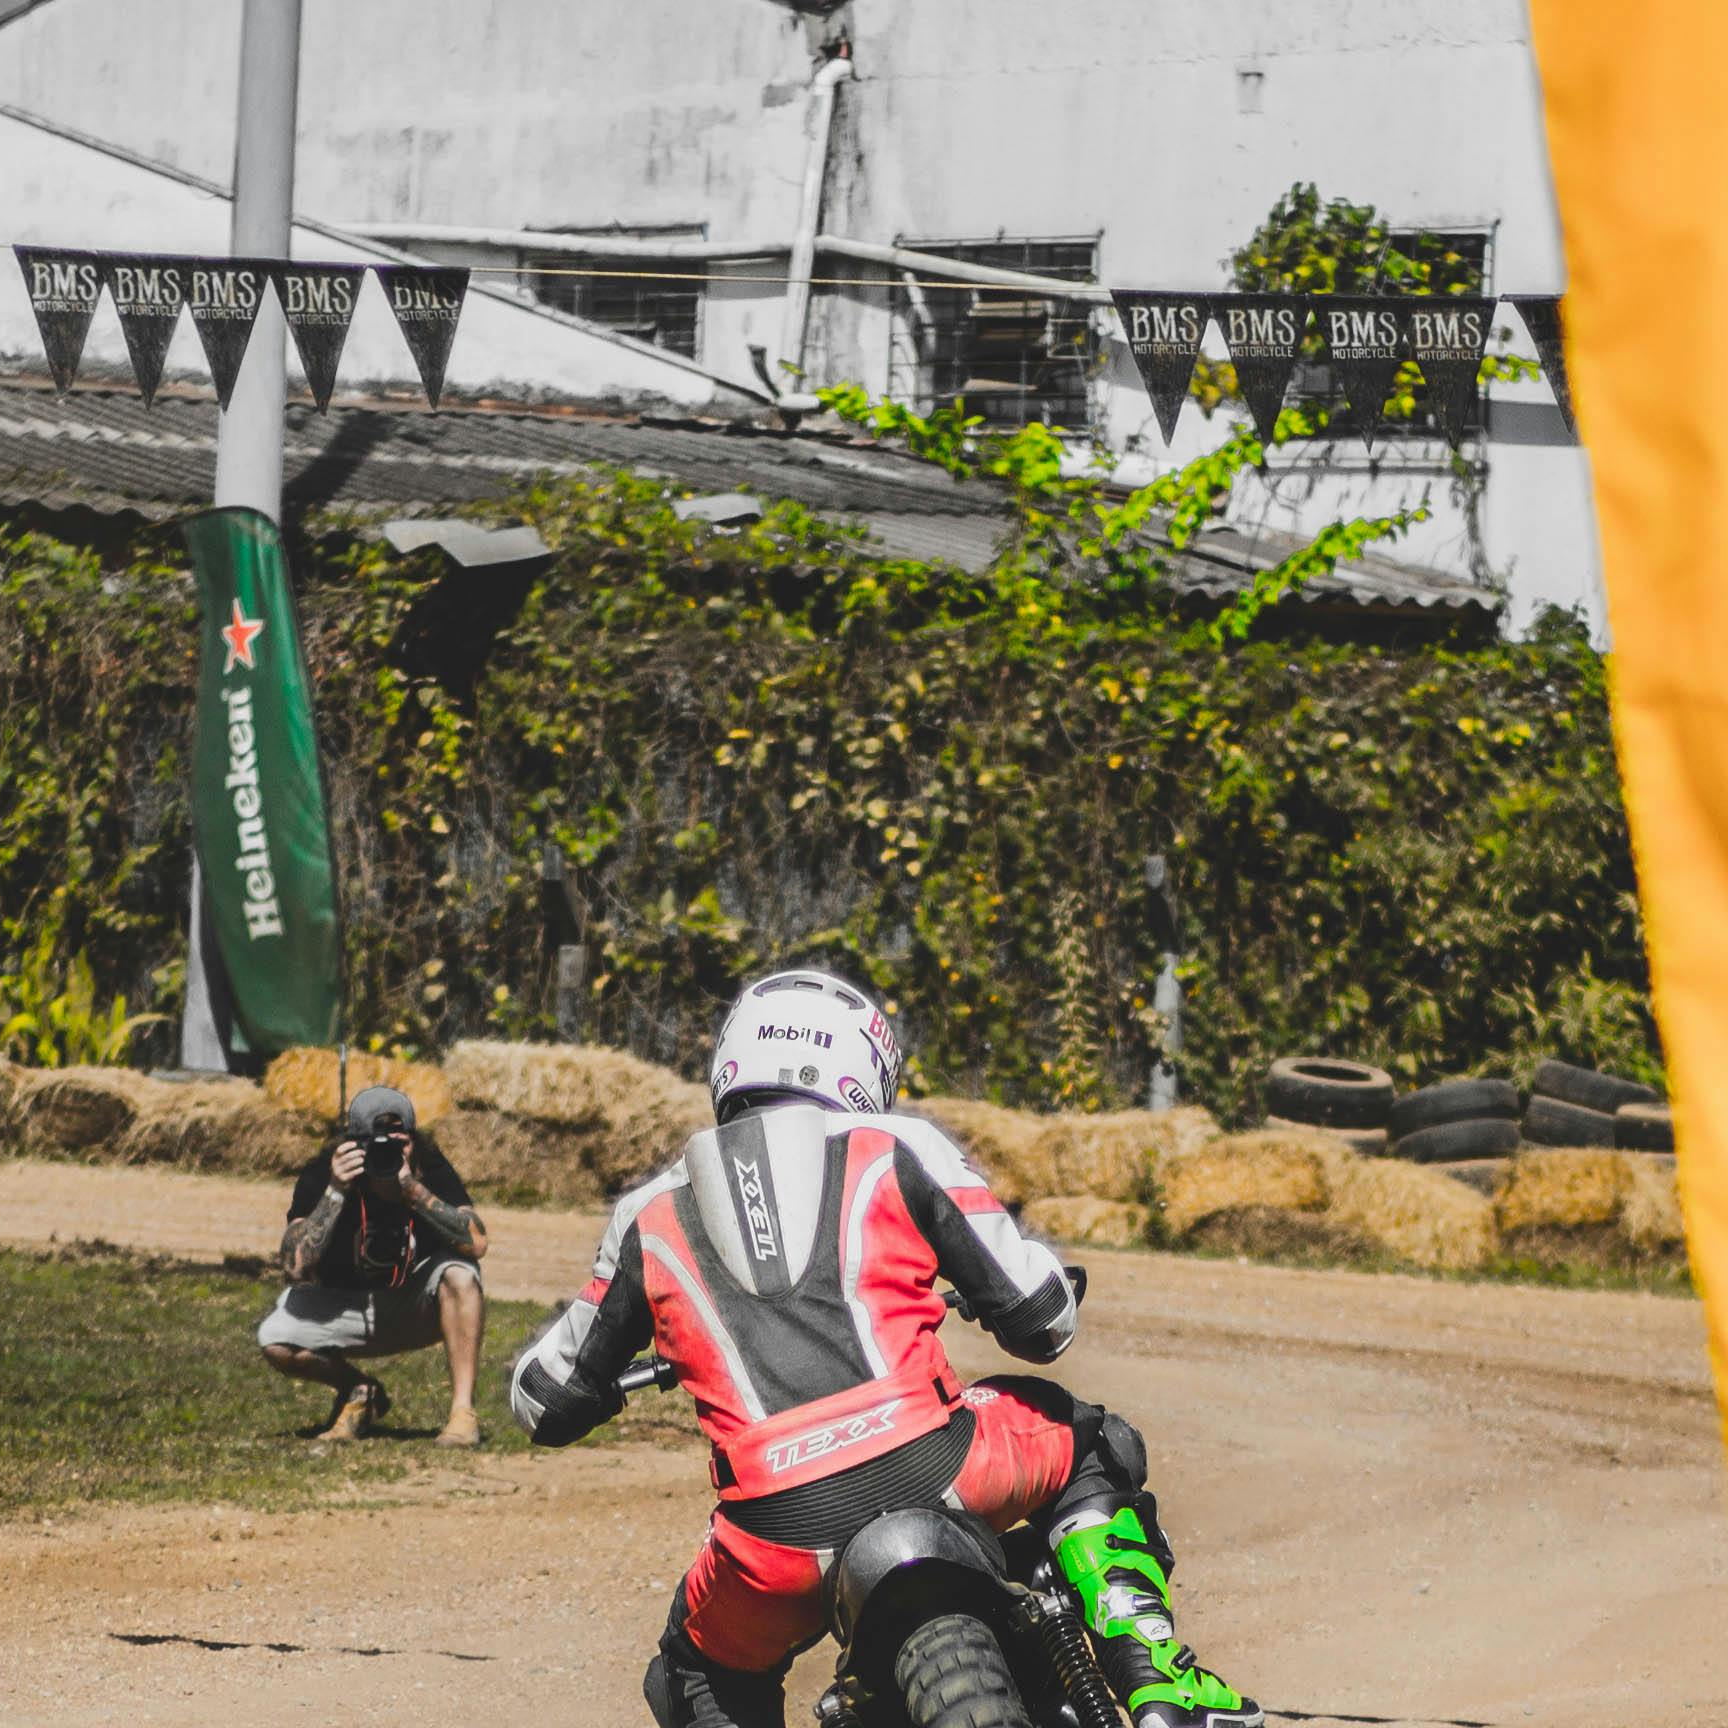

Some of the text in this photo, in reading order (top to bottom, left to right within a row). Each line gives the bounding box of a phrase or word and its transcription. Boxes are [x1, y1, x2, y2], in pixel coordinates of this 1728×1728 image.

[32, 262, 98, 301] BMS
[115, 268, 181, 305] BMS
[191, 271, 257, 308] BMS
[284, 276, 352, 314] BMS
[33, 300, 96, 313] MOTORCYCLE
[118, 304, 179, 317] MOTORCYCLE
[193, 307, 253, 320] MOTORCYCLE
[288, 313, 351, 326] MOTORCYCLE
[396, 309, 459, 322] MOTORCYCLE
[1129, 306, 1199, 343] BMS
[1227, 309, 1296, 346] BMS
[1328, 311, 1398, 348] BMS
[1411, 312, 1483, 349] BMS
[1134, 343, 1198, 355] MOTORCYCLE
[1231, 346, 1294, 358] MOTORCYCLE
[1332, 347, 1397, 359] MOTORCYCLE
[1416, 349, 1481, 362] MOTORCYCLE
[220, 685, 285, 942] Heineken
[757, 1025, 811, 1043] Mobil
[733, 1156, 778, 1262] TEXX
[766, 1398, 904, 1474] TEXX
